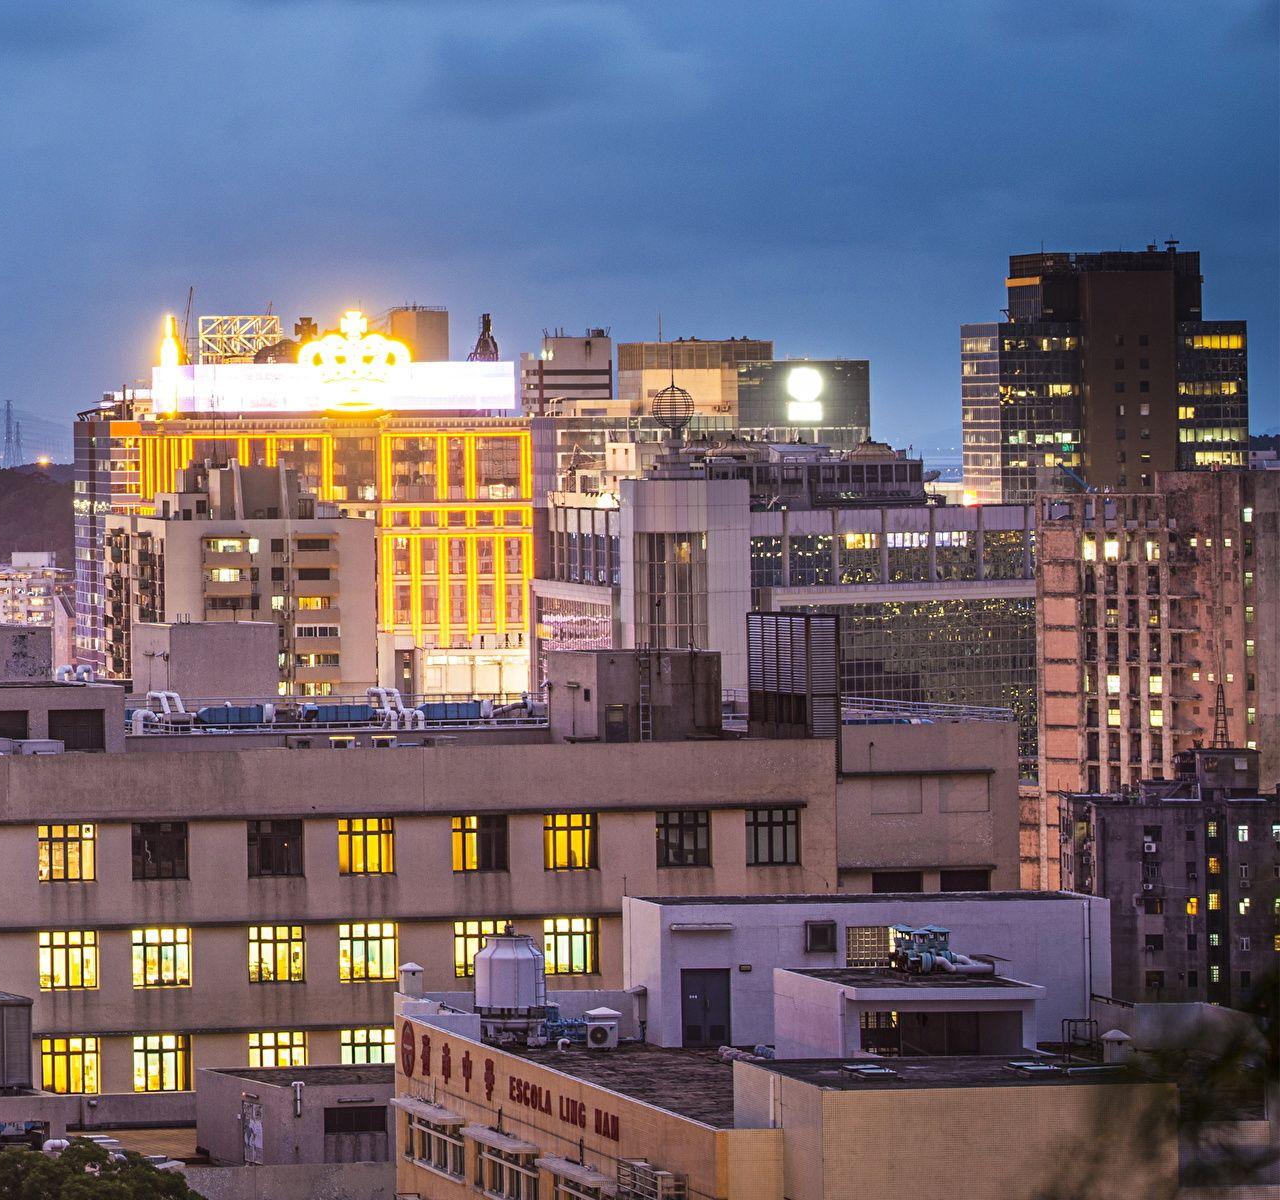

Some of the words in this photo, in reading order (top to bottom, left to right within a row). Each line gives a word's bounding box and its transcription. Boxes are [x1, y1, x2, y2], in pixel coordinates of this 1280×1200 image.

[509, 1075, 552, 1116] ESCOLA
[559, 1095, 586, 1129] LING
[595, 1108, 619, 1142] NAN
